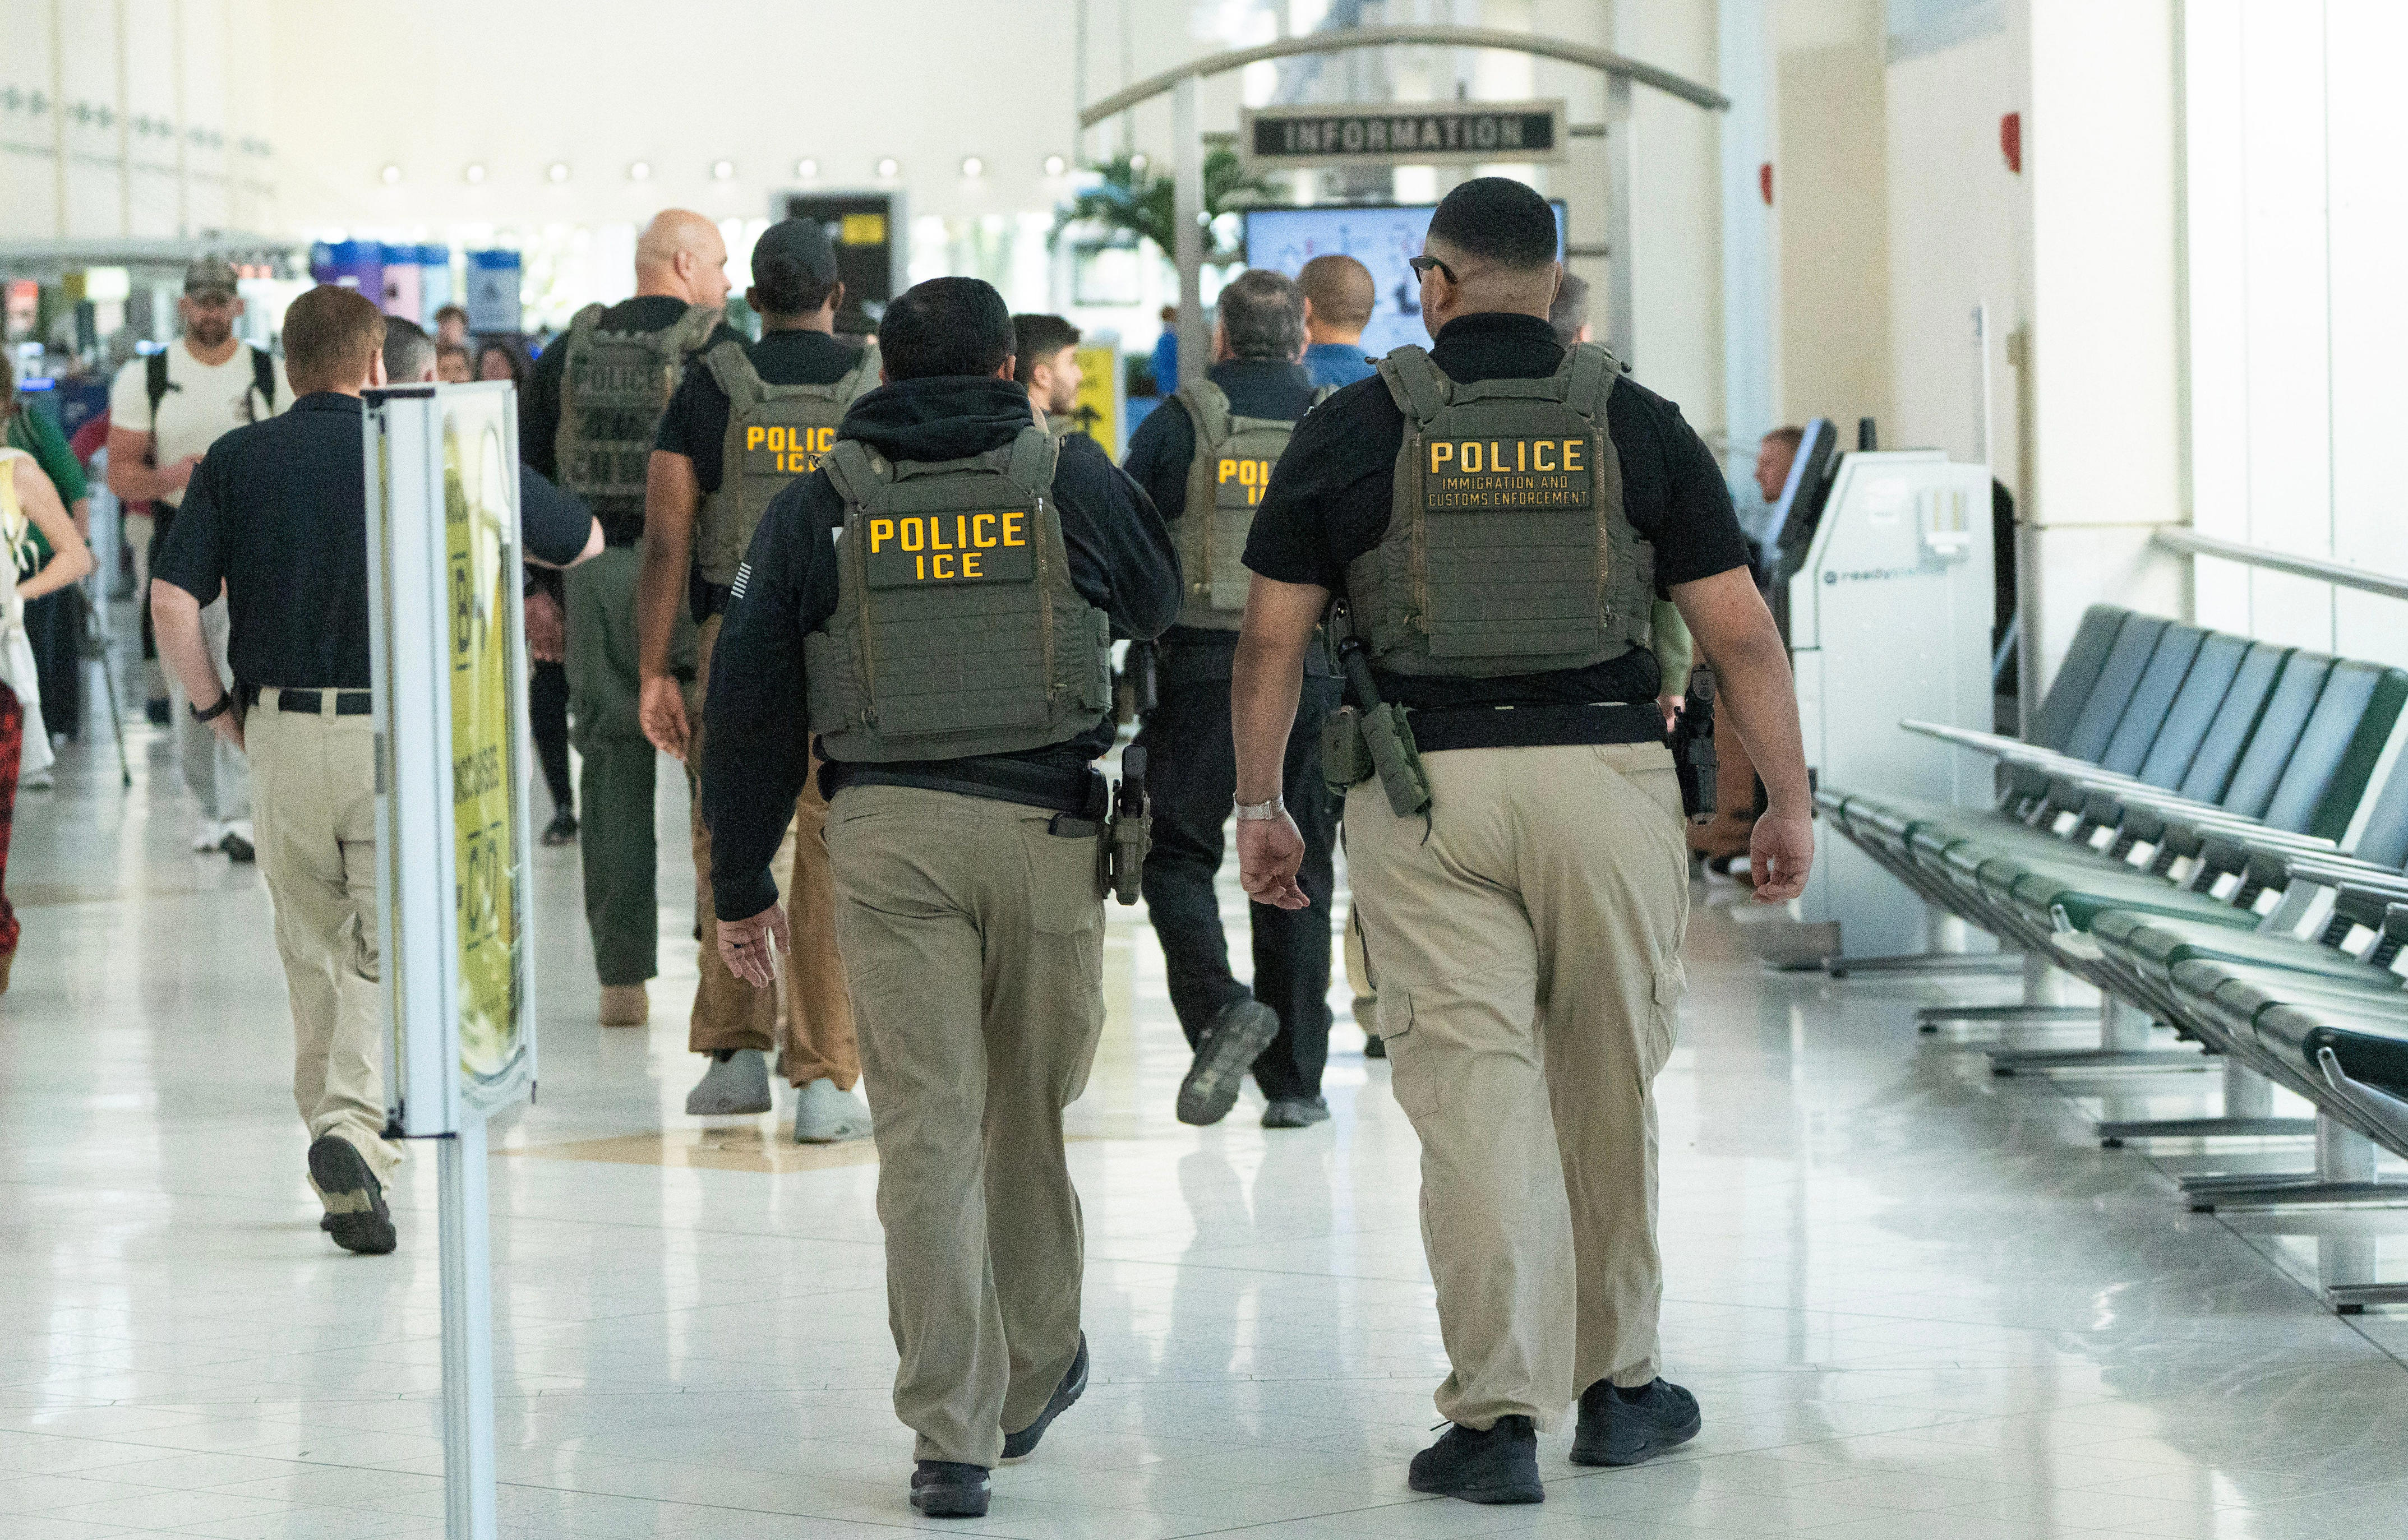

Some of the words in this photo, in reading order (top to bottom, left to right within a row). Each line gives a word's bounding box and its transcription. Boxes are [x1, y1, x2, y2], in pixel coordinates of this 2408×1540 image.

[1284, 117, 1523, 151] INFORMATION
[573, 364, 658, 392] POLICE
[746, 426, 836, 453] POLIC
[1431, 440, 1584, 473] POLICE
[1218, 459, 1270, 485] POL
[1442, 476, 1534, 490] IMMIGRATION
[1540, 475, 1568, 489] AND
[1429, 492, 1488, 506] CUSTOMS
[1494, 491, 1586, 505] ENFORCEMENT
[870, 512, 1026, 554] POLICE
[916, 552, 984, 581] ICE
